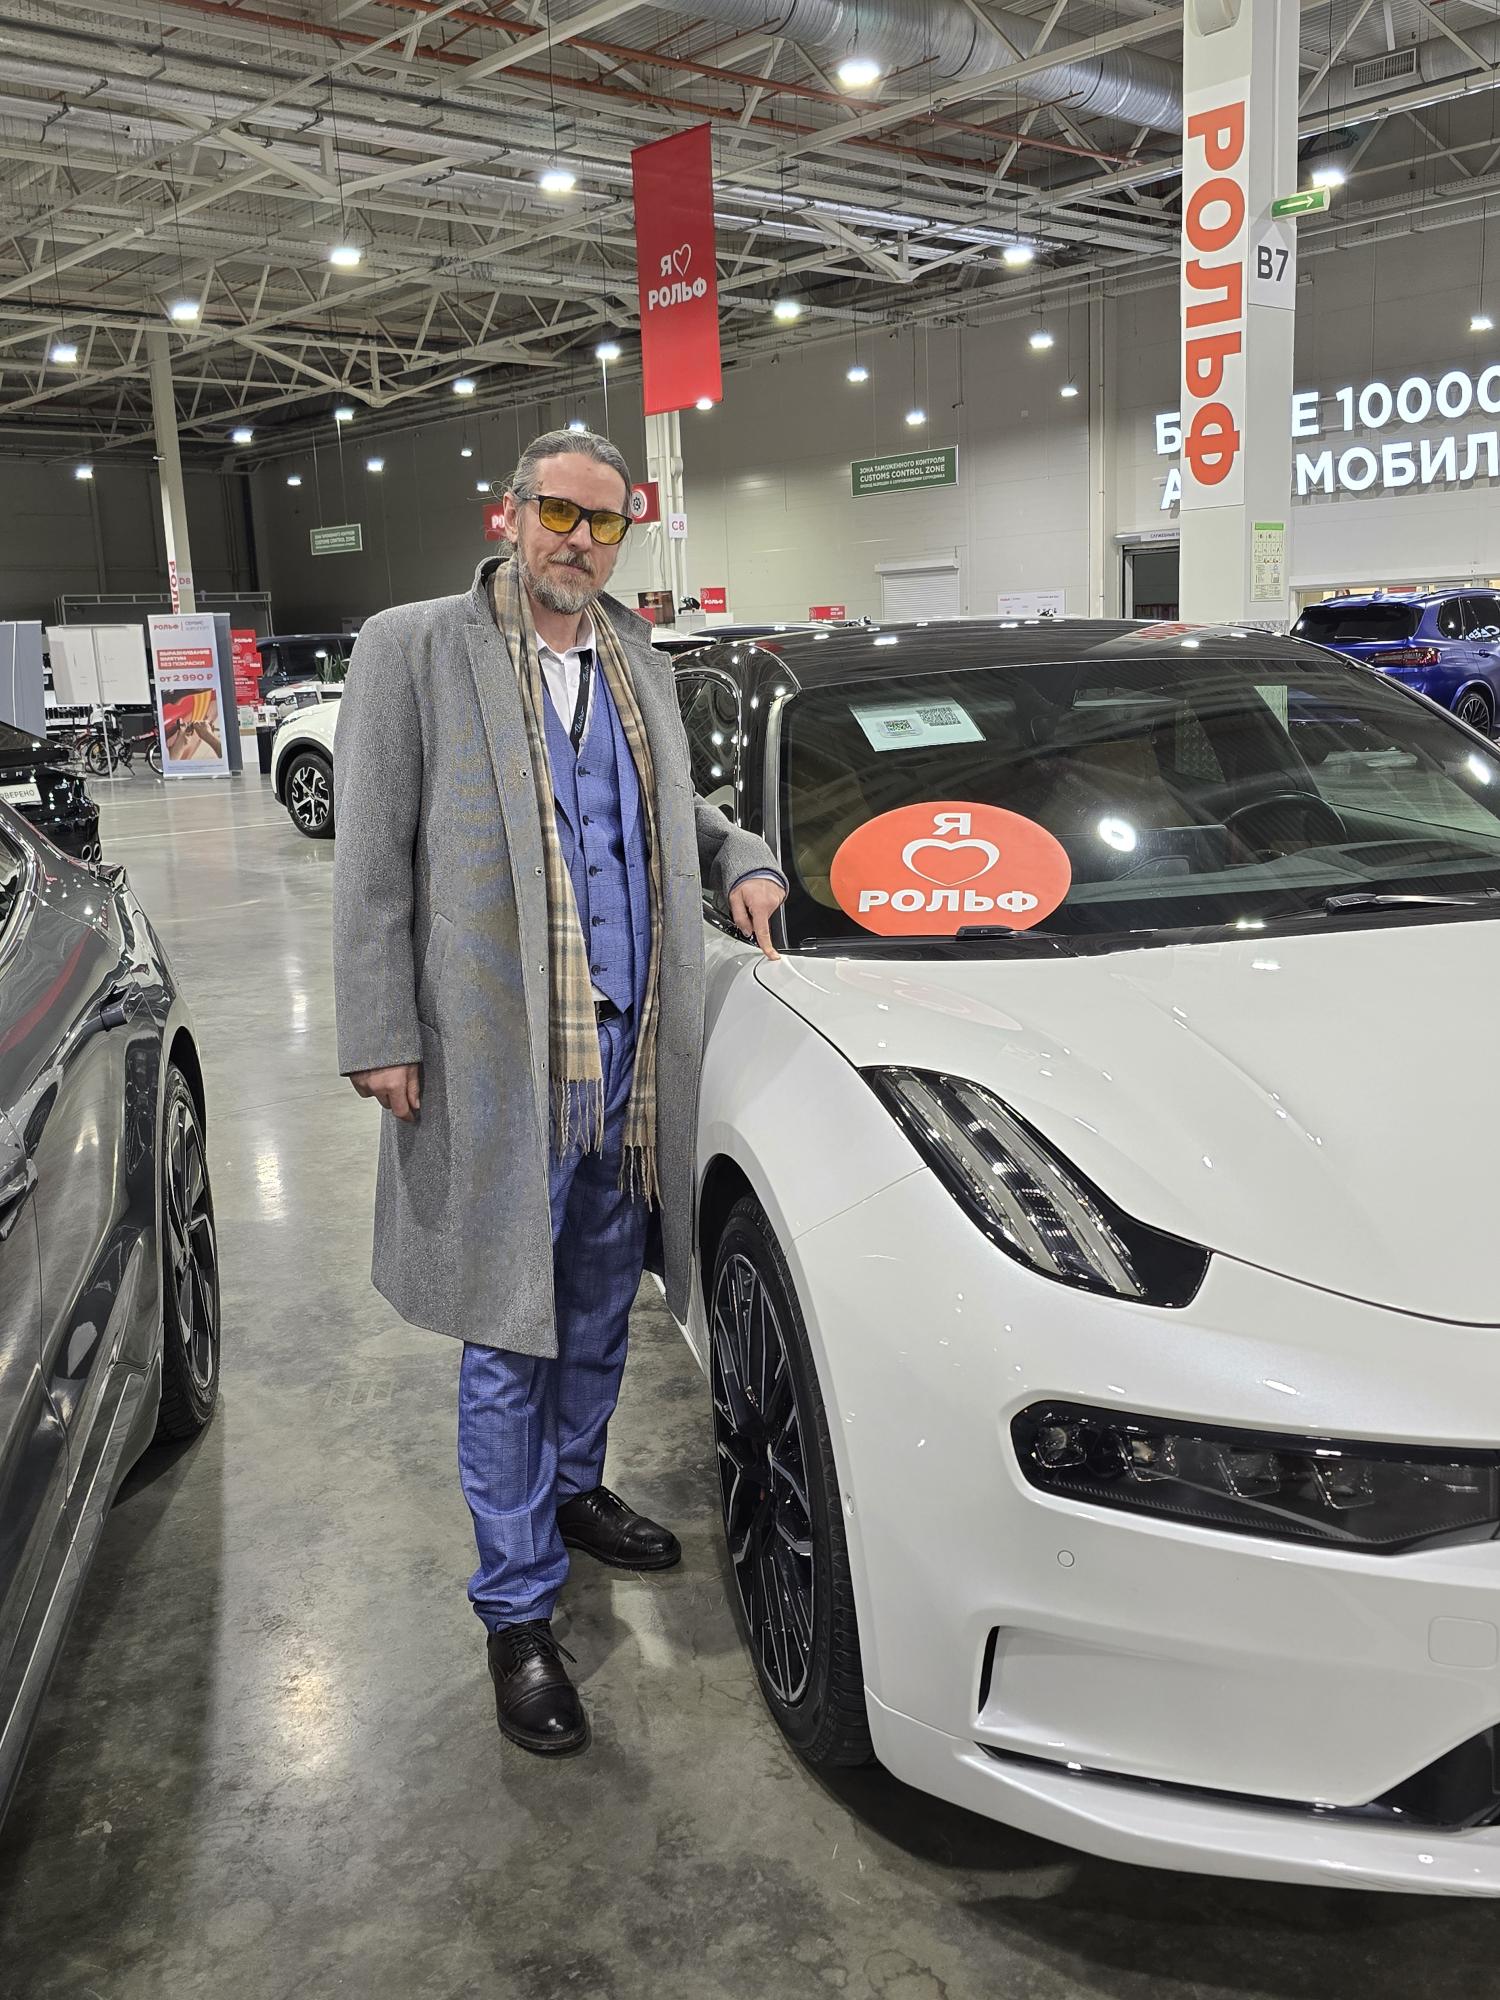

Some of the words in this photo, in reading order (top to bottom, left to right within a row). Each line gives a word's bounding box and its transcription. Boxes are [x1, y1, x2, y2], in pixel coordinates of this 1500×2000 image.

[660, 254, 672, 277] Я
[648, 277, 707, 311] РОЛЬФ
[1186, 101, 1246, 486] РОЛЬФ
[860, 467, 874, 475] ЗОНА
[860, 473, 890, 483] CUSTOMS
[891, 468, 924, 478] CONTROL
[925, 465, 945, 474] ZONE
[169, 561, 180, 615] РОЛЬ
[932, 812, 972, 836] Я
[858, 889, 1039, 913] РОЛЬФ
